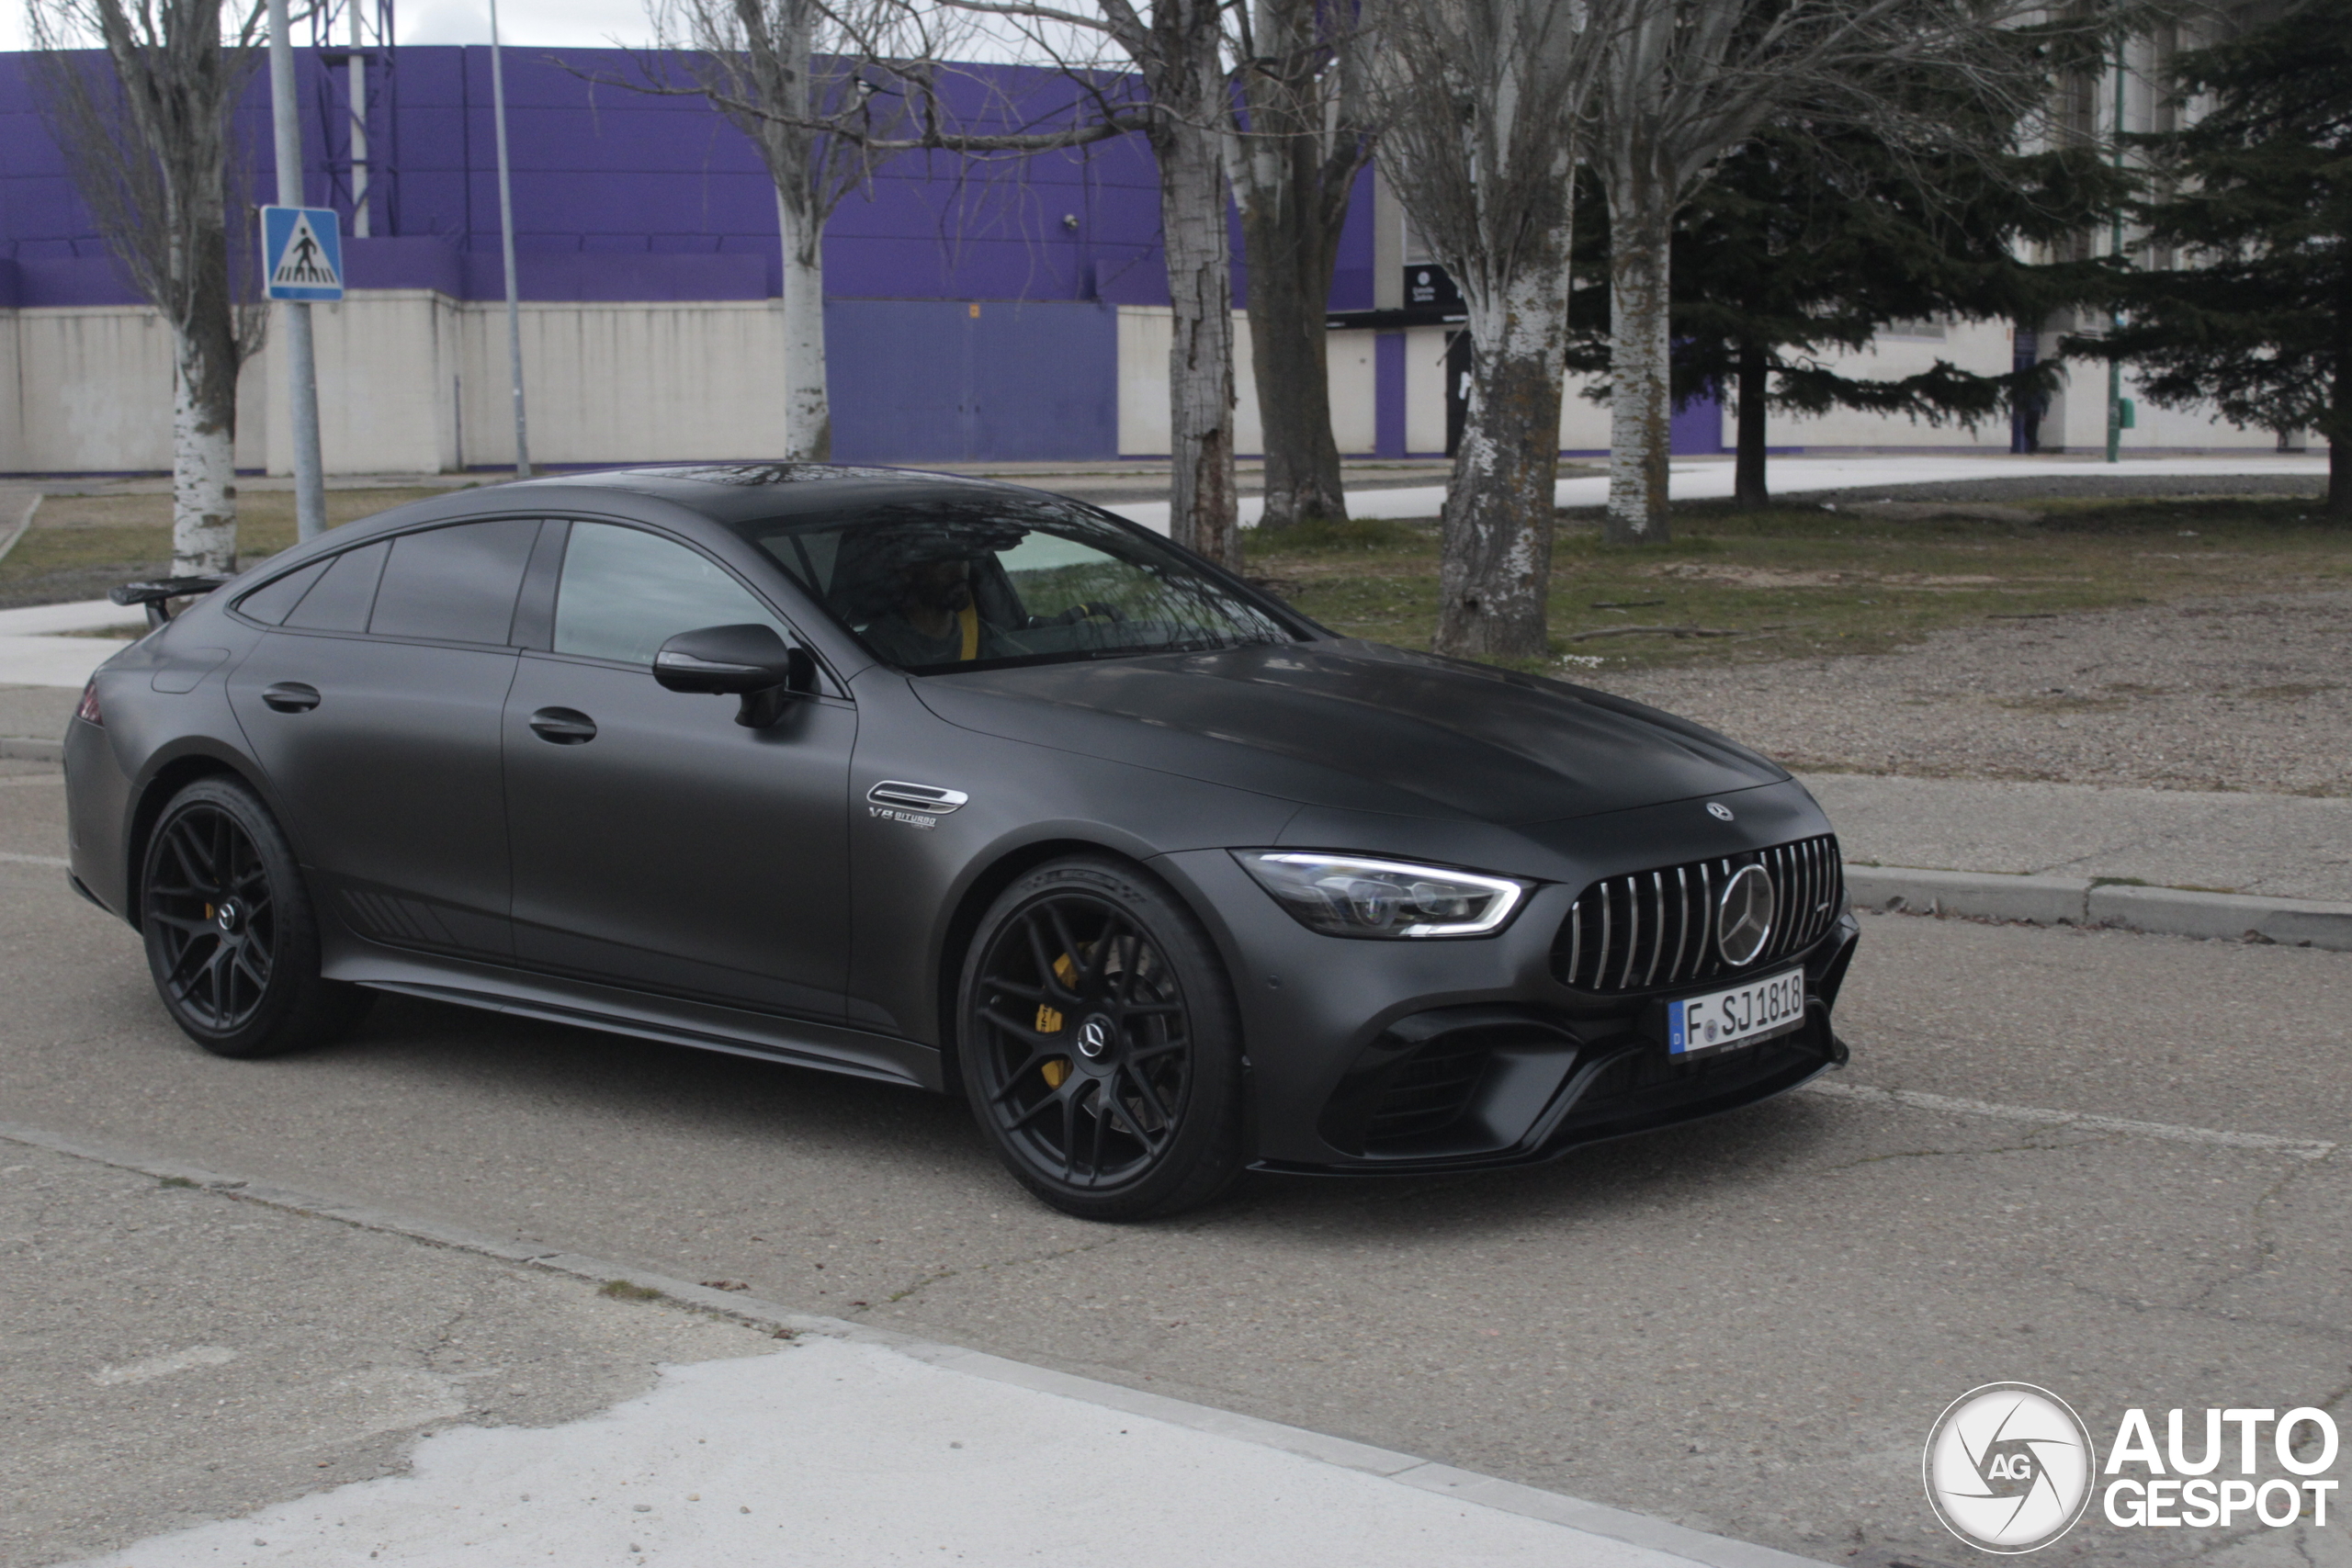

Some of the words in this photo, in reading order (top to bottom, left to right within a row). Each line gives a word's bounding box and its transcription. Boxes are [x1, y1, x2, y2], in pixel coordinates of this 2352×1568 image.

[868, 807, 894, 820] V8
[894, 812, 937, 825] BITURBO
[1687, 1002, 1703, 1044] F
